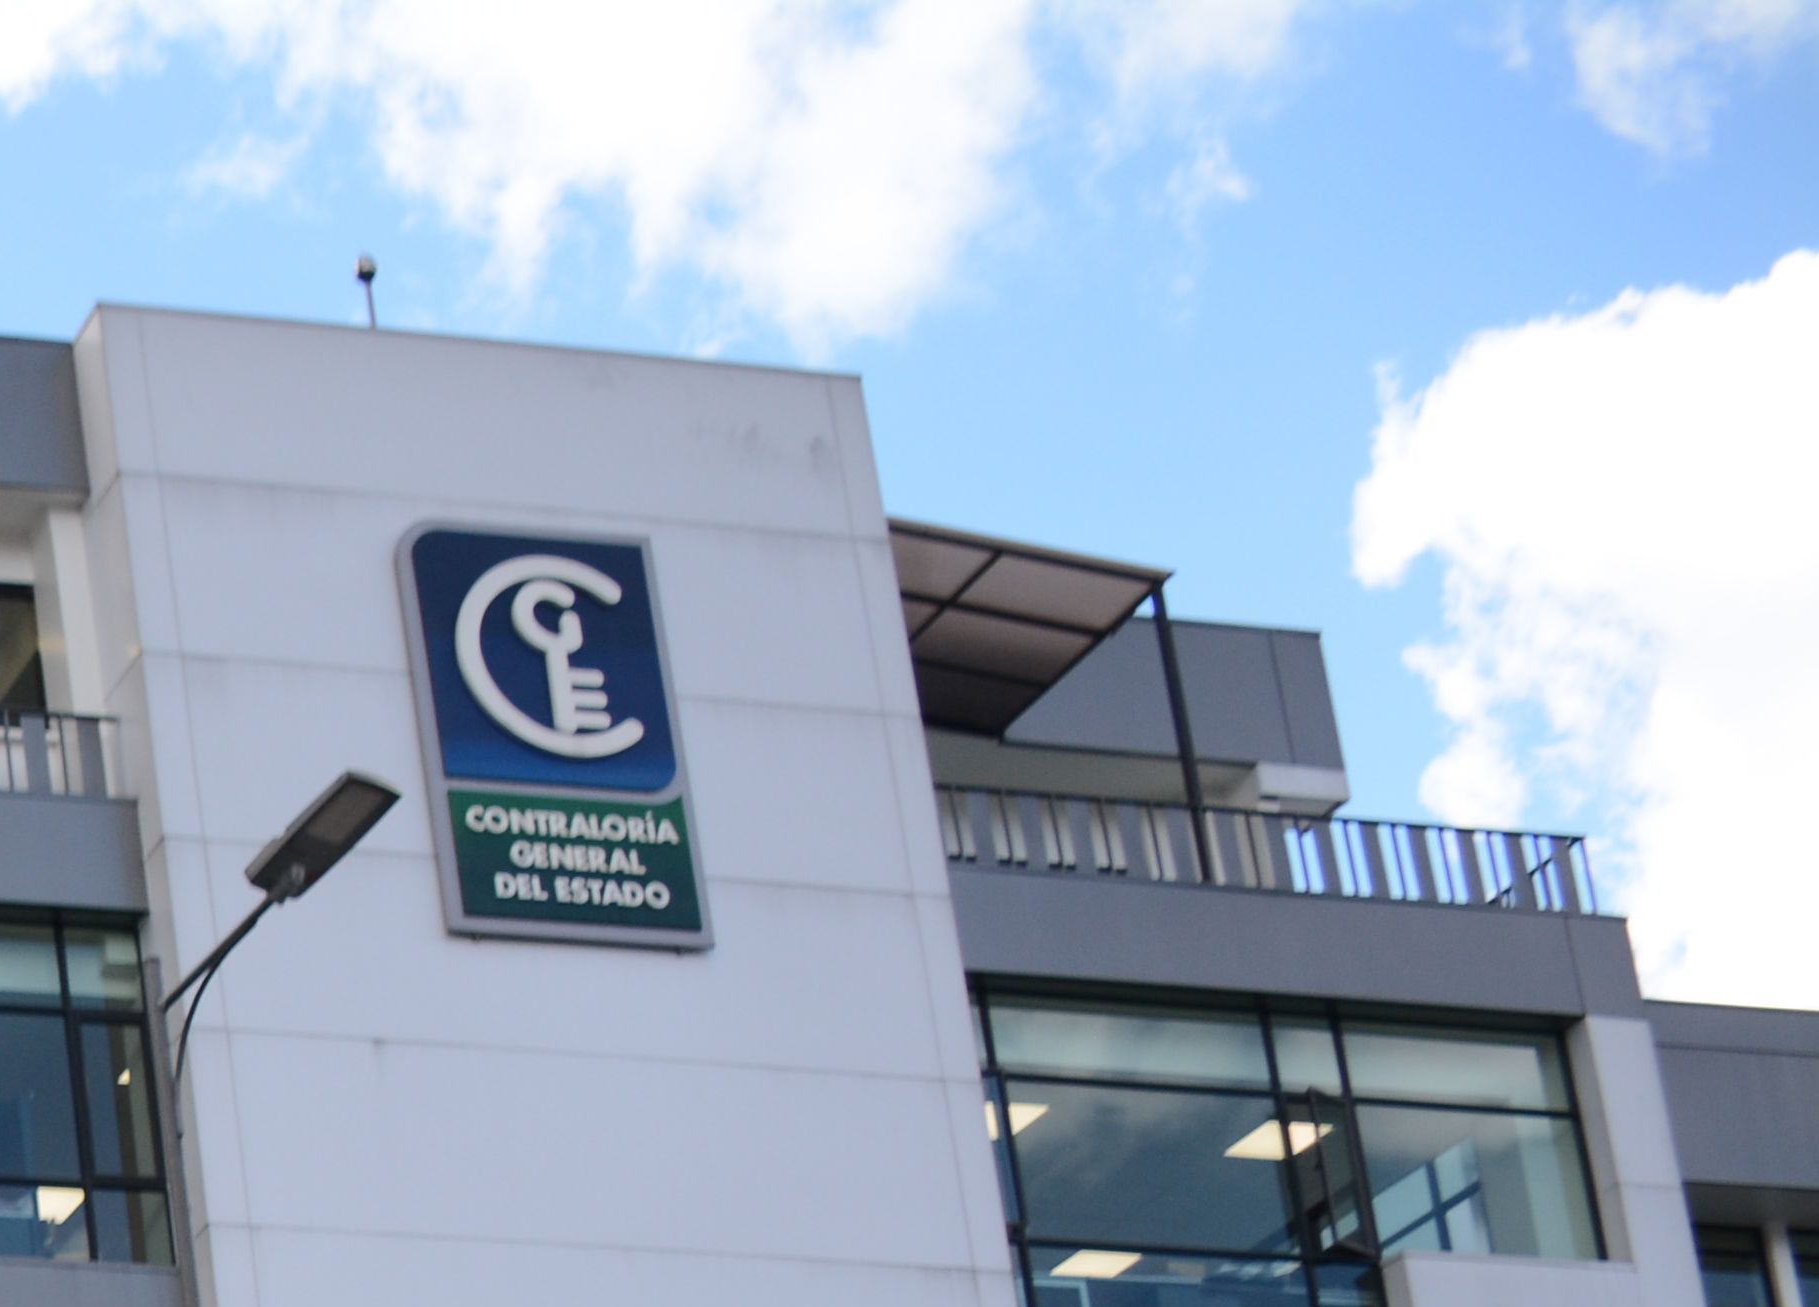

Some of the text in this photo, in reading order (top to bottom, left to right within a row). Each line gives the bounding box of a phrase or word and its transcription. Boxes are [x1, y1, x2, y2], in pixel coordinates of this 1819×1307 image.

[465, 804, 680, 845] CONTRALORÍA
[509, 840, 646, 875] GENERAL
[494, 871, 670, 909] DEL ESTADO
